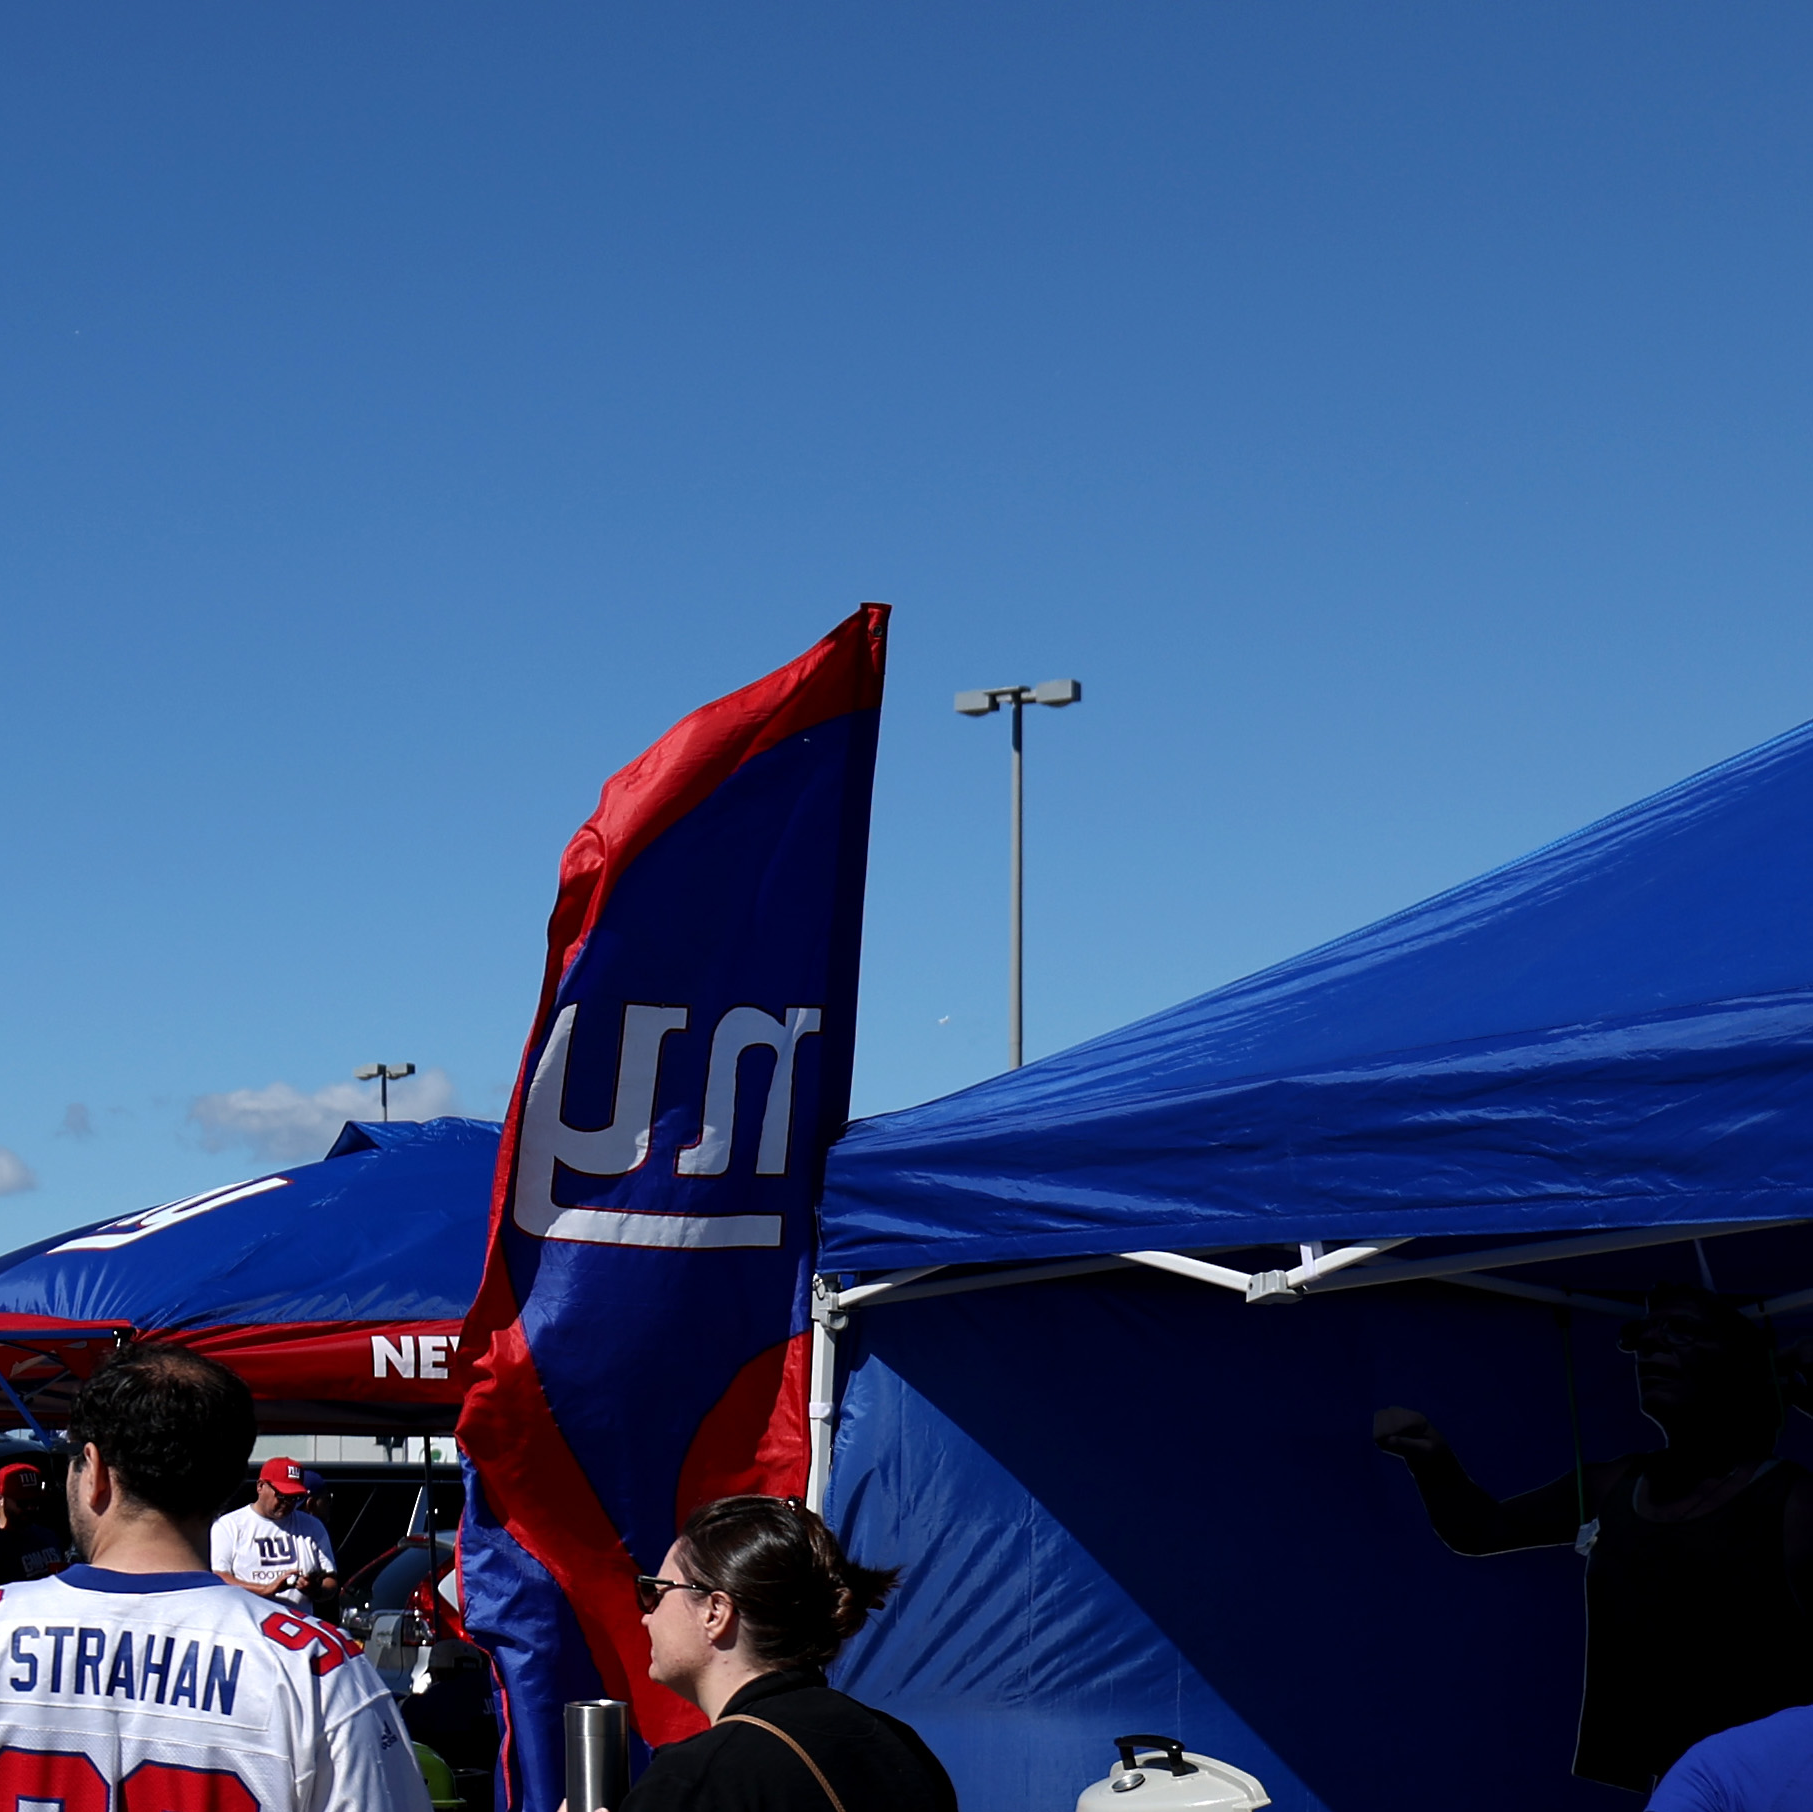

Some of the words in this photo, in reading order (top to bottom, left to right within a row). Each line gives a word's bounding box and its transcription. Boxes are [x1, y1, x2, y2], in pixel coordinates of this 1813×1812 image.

[371, 1335, 461, 1379] NE
[254, 1536, 298, 1567] ny
[9, 1625, 244, 1716] STRAHAN
